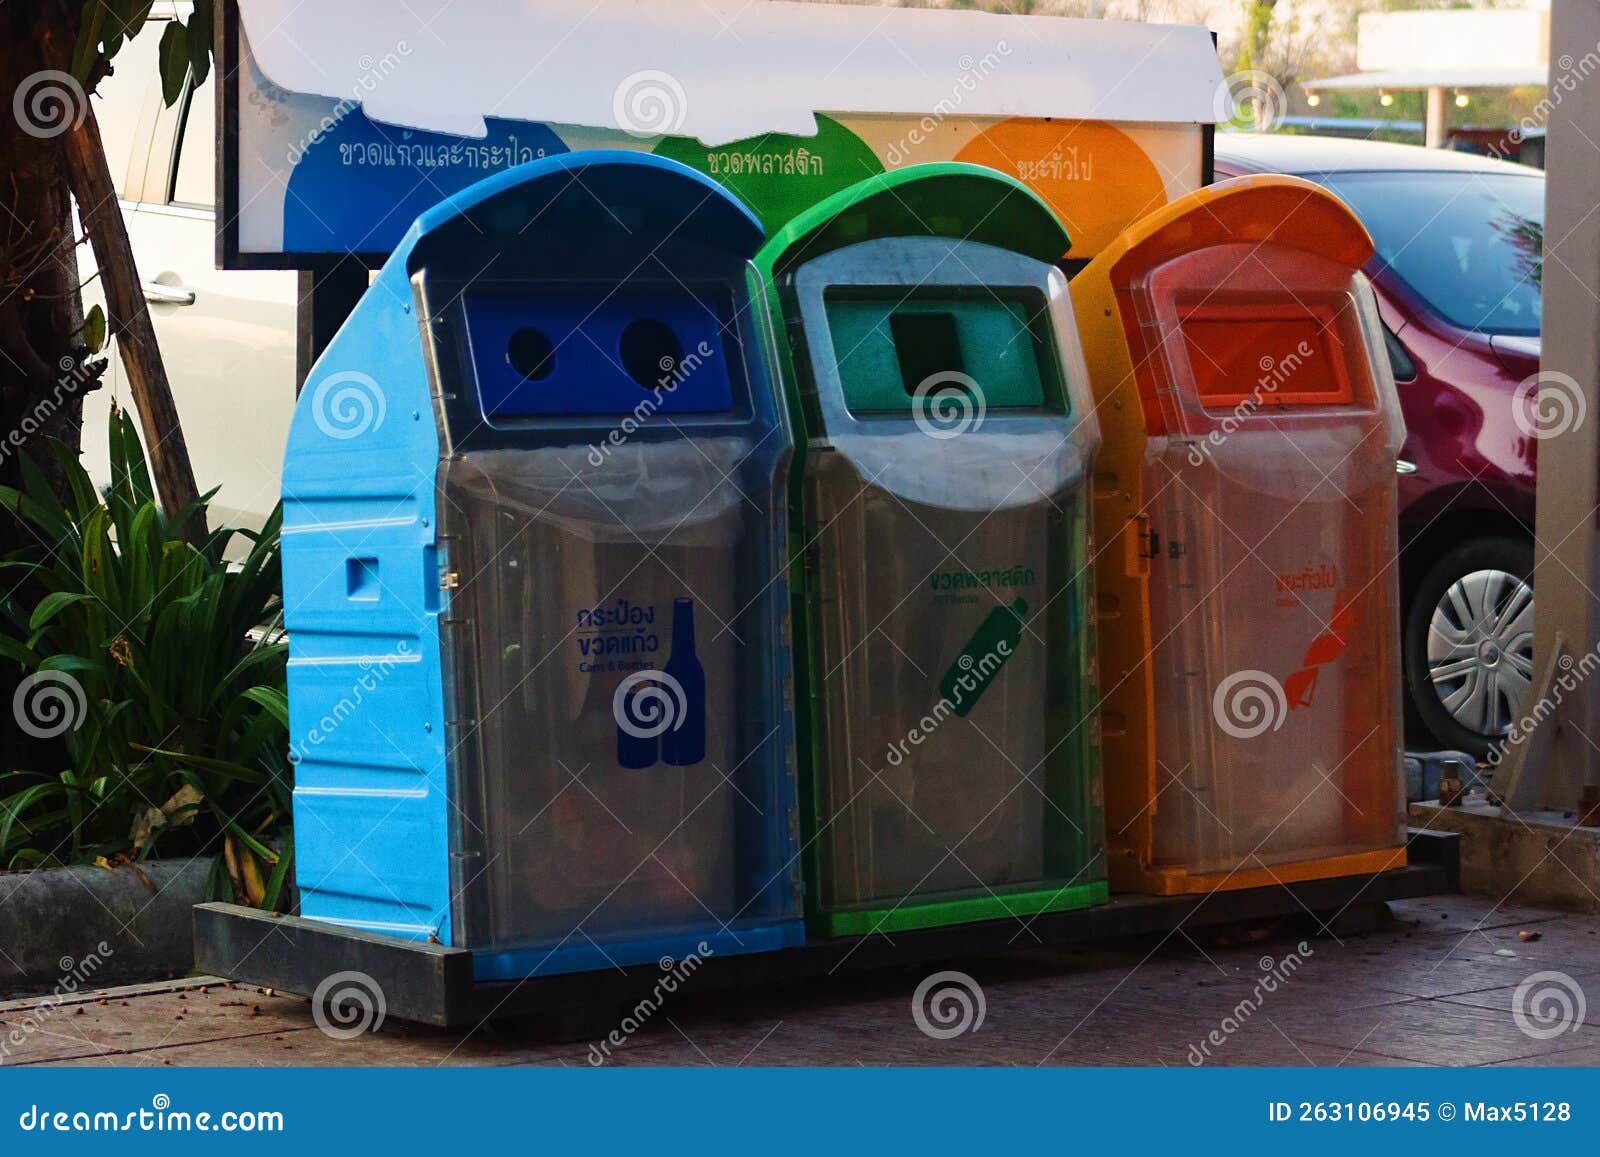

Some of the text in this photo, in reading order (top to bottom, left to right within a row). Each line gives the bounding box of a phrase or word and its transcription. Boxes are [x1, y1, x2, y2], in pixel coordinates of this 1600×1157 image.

[707, 147, 823, 176] ขวดพลาสติก
[1016, 145, 1092, 181] ขยะทั่วไป
[929, 565, 1035, 590] ขวดพลาสติก
[577, 598, 656, 627] กระป๋อง
[577, 627, 659, 656] ขวดแก้ว
